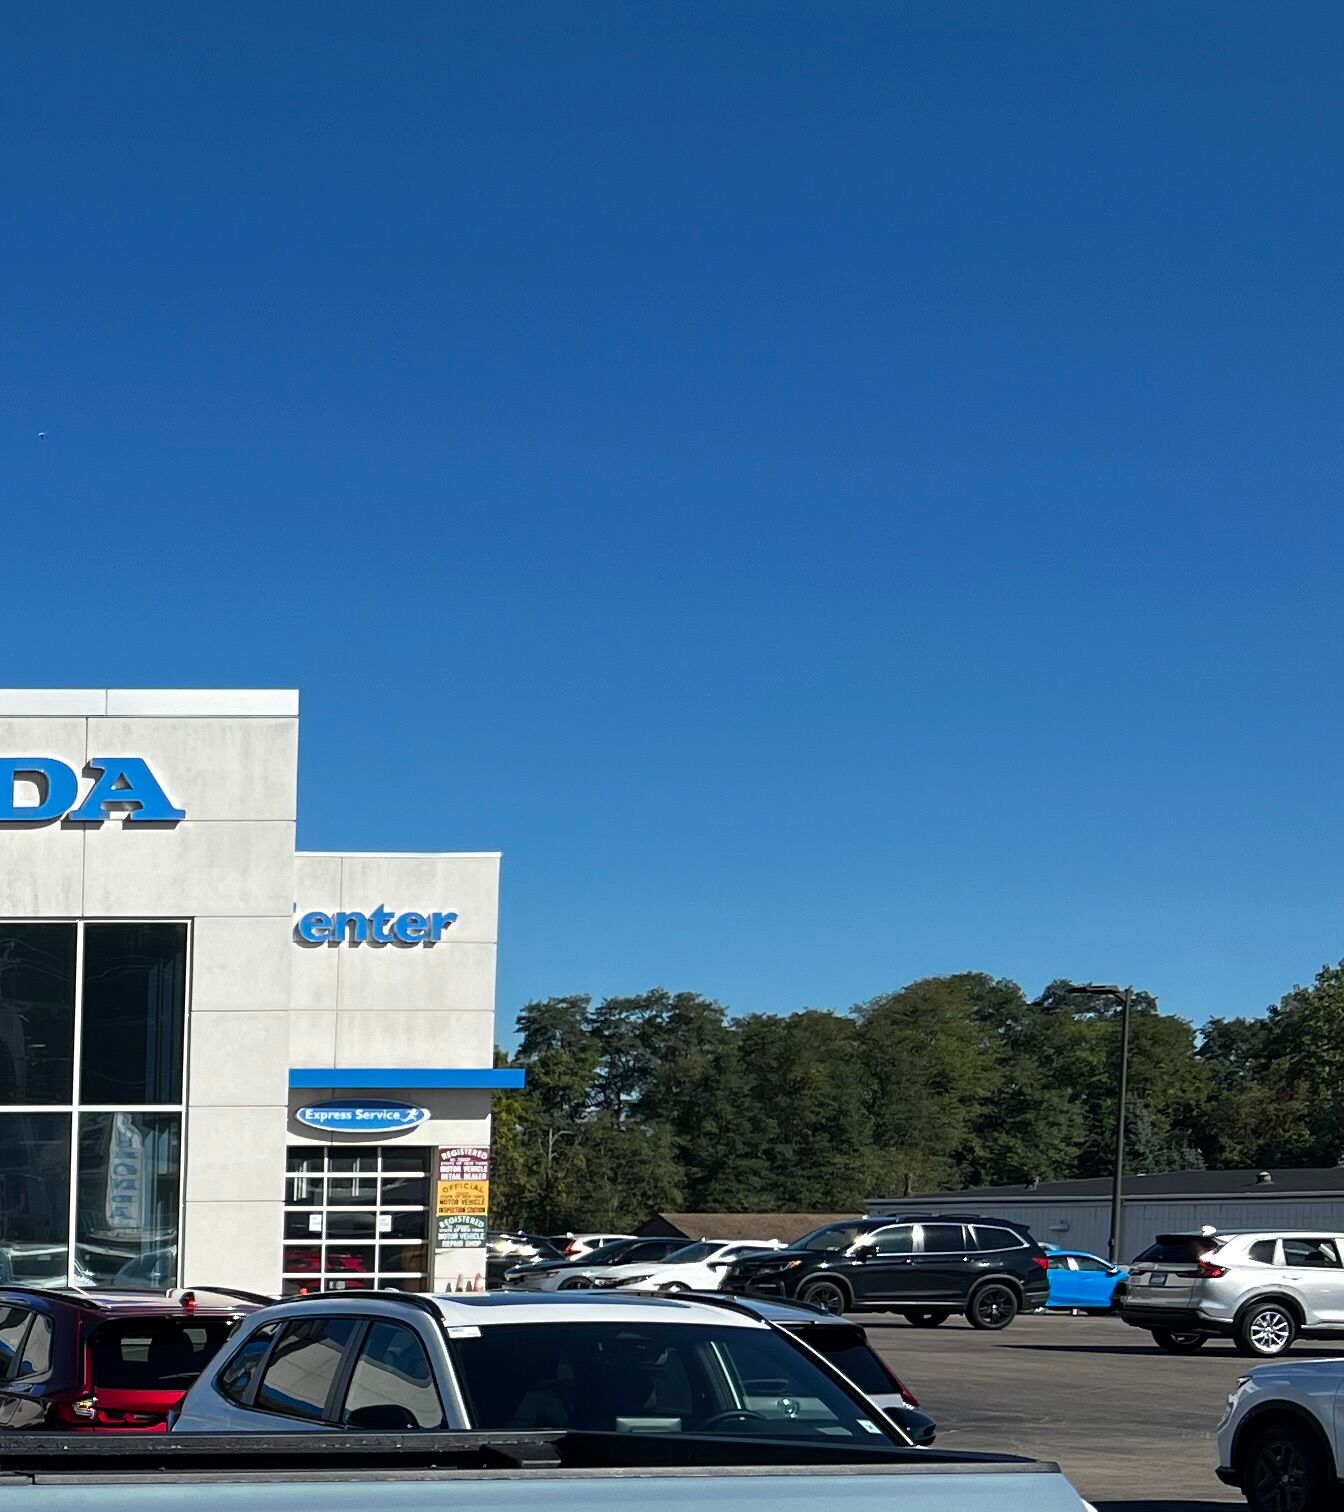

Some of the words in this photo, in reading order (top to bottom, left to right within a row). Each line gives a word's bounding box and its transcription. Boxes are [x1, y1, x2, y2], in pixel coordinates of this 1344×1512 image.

[293, 902, 459, 943] enter
[305, 1109, 352, 1123] Express
[355, 1108, 401, 1120] Service
[441, 1148, 487, 1160] REGISTERED
[443, 1183, 485, 1193] OFFICIAL
[439, 1216, 485, 1228] REGISTERED
